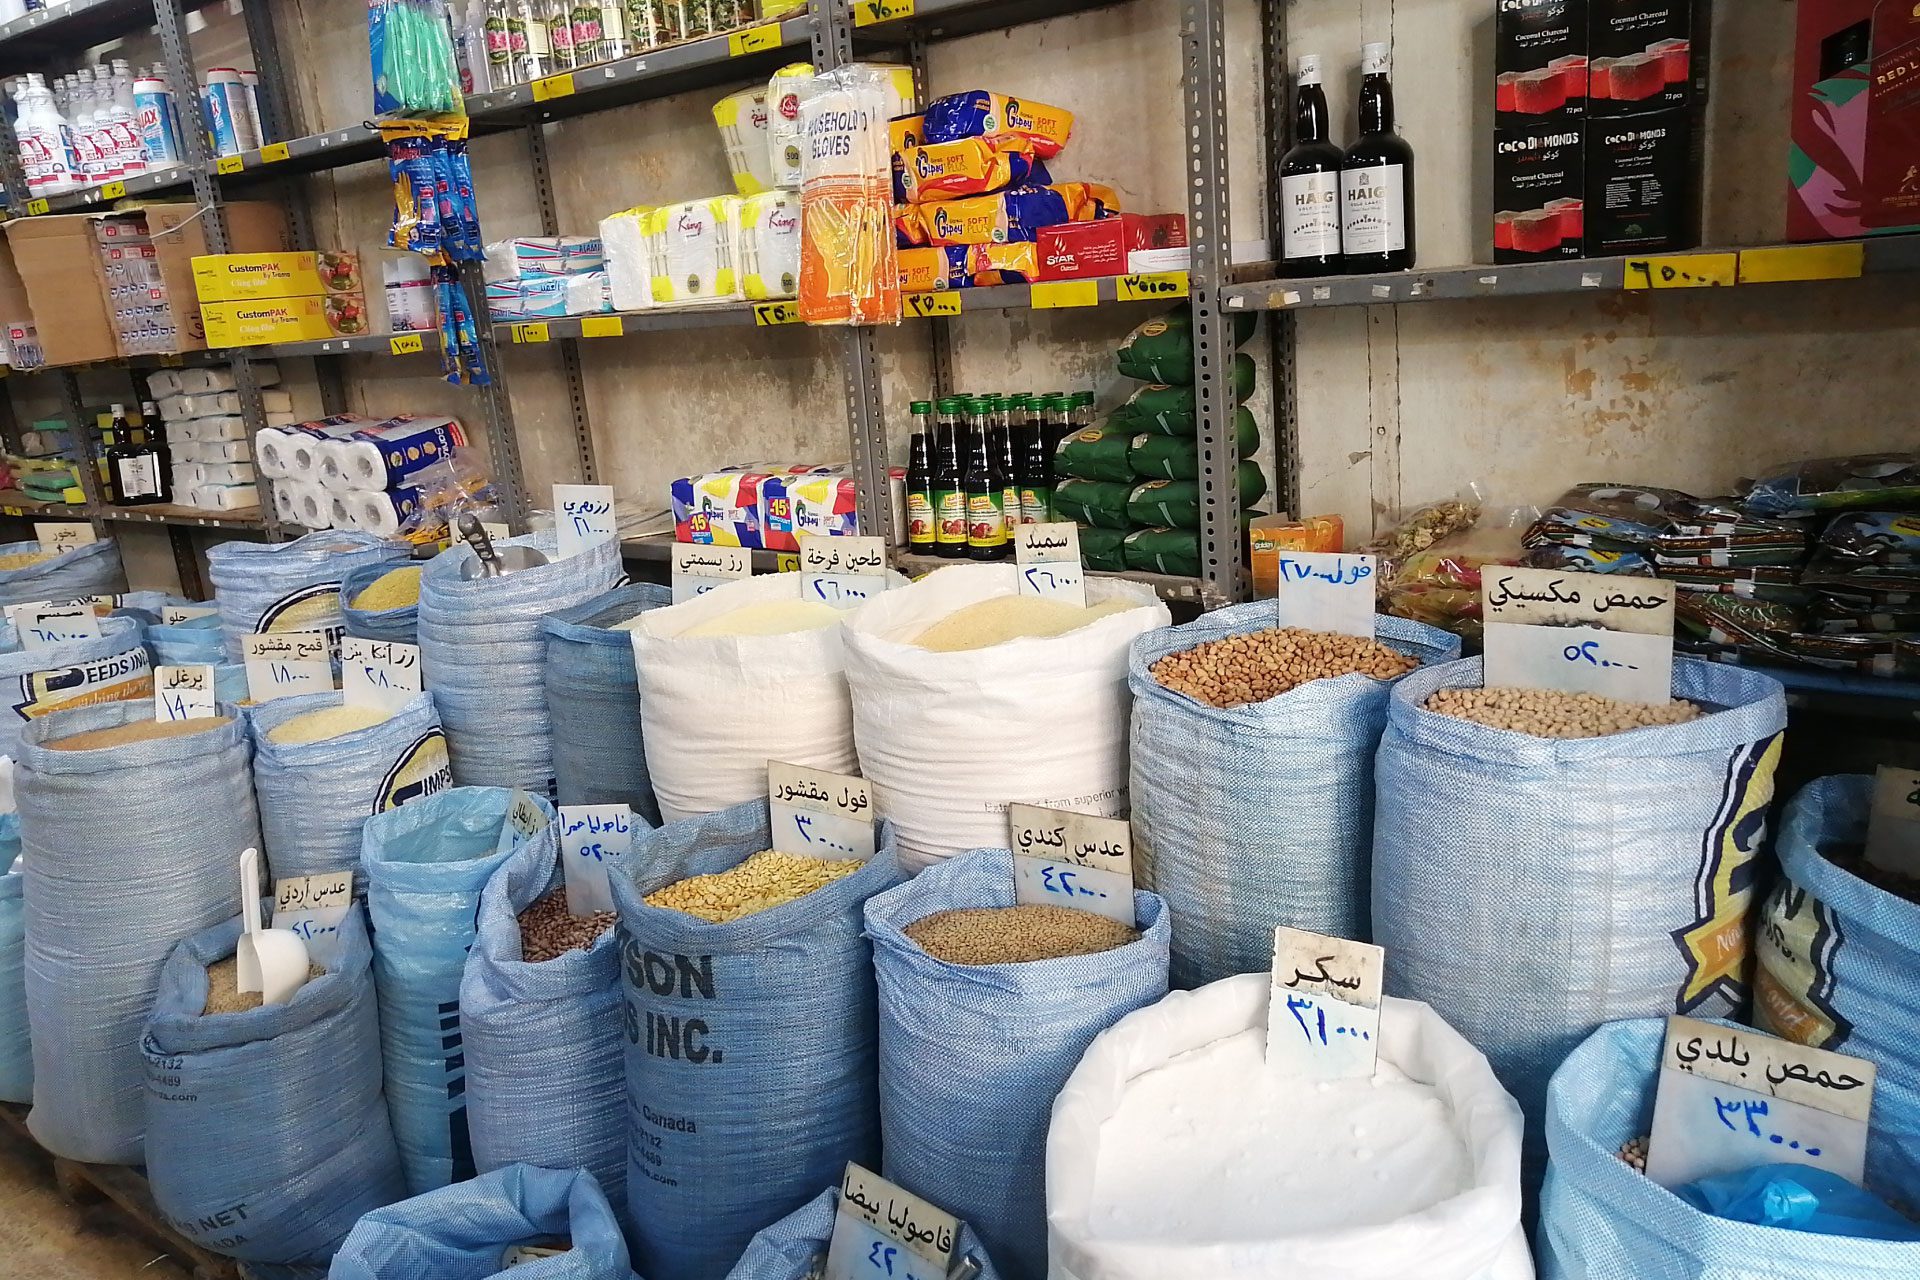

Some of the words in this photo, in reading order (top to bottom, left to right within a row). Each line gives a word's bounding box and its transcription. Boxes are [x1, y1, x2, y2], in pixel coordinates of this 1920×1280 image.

[1610, 15, 1637, 25] Coconut
[1638, 9, 1669, 21] Charcoal
[1515, 30, 1541, 42] Coconut
[1541, 26, 1569, 38] Charcoal
[1877, 67, 1905, 84] RED
[1037, 117, 1057, 126] SOFT
[812, 135, 851, 159] GLOVES
[946, 154, 965, 163] SOFT
[1512, 174, 1537, 182] Coconut
[1537, 171, 1564, 180] Charcoal
[1348, 186, 1386, 201] HAIG
[678, 214, 702, 235] King
[769, 210, 796, 234] King
[967, 217, 988, 225] SOFT
[228, 263, 280, 273] CustomPAK
[912, 267, 930, 275] SOFT
[1047, 255, 1076, 265] STAR
[237, 309, 288, 320] CustomPAK
[1026, 534, 1068, 556] سميد
[680, 555, 723, 574] بسمتي
[728, 553, 743, 572] رز
[808, 548, 840, 571] فرخة
[845, 549, 882, 572] طحين
[813, 579, 866, 600] ٢٦٠٠٠
[1025, 567, 1077, 594] ٢٦٠٠٠
[1488, 576, 1581, 612] مكسيكي
[1593, 590, 1668, 612] حمص
[251, 638, 292, 655] مقشور
[297, 638, 323, 657] قمح
[1563, 641, 1639, 670] ٥٢٠٠٠
[395, 649, 415, 668] رز
[169, 669, 203, 690] برغل
[365, 666, 411, 691] ٢٨٠٠٠
[775, 780, 829, 802] مقشور
[837, 787, 868, 813] فول
[1075, 789, 1115, 806] superior
[1017, 827, 1066, 854] كندي
[1074, 841, 1125, 858] عدس
[580, 844, 620, 862] ٥٢٠٠٠
[280, 879, 310, 910] أردني
[313, 881, 346, 903] عدس
[1284, 955, 1361, 990] سكر
[1286, 994, 1370, 1046] ٣١٠٠٠
[646, 1011, 723, 1064] INC.
[1676, 1036, 1751, 1079] بلدي
[1766, 1060, 1865, 1091] حمص
[642, 1104, 697, 1134] Canada
[1714, 1096, 1822, 1157] ٣٣٠٠٠
[844, 1175, 881, 1224] بيضا
[199, 1202, 250, 1232] NET
[887, 1199, 952, 1254] فاصوليا
